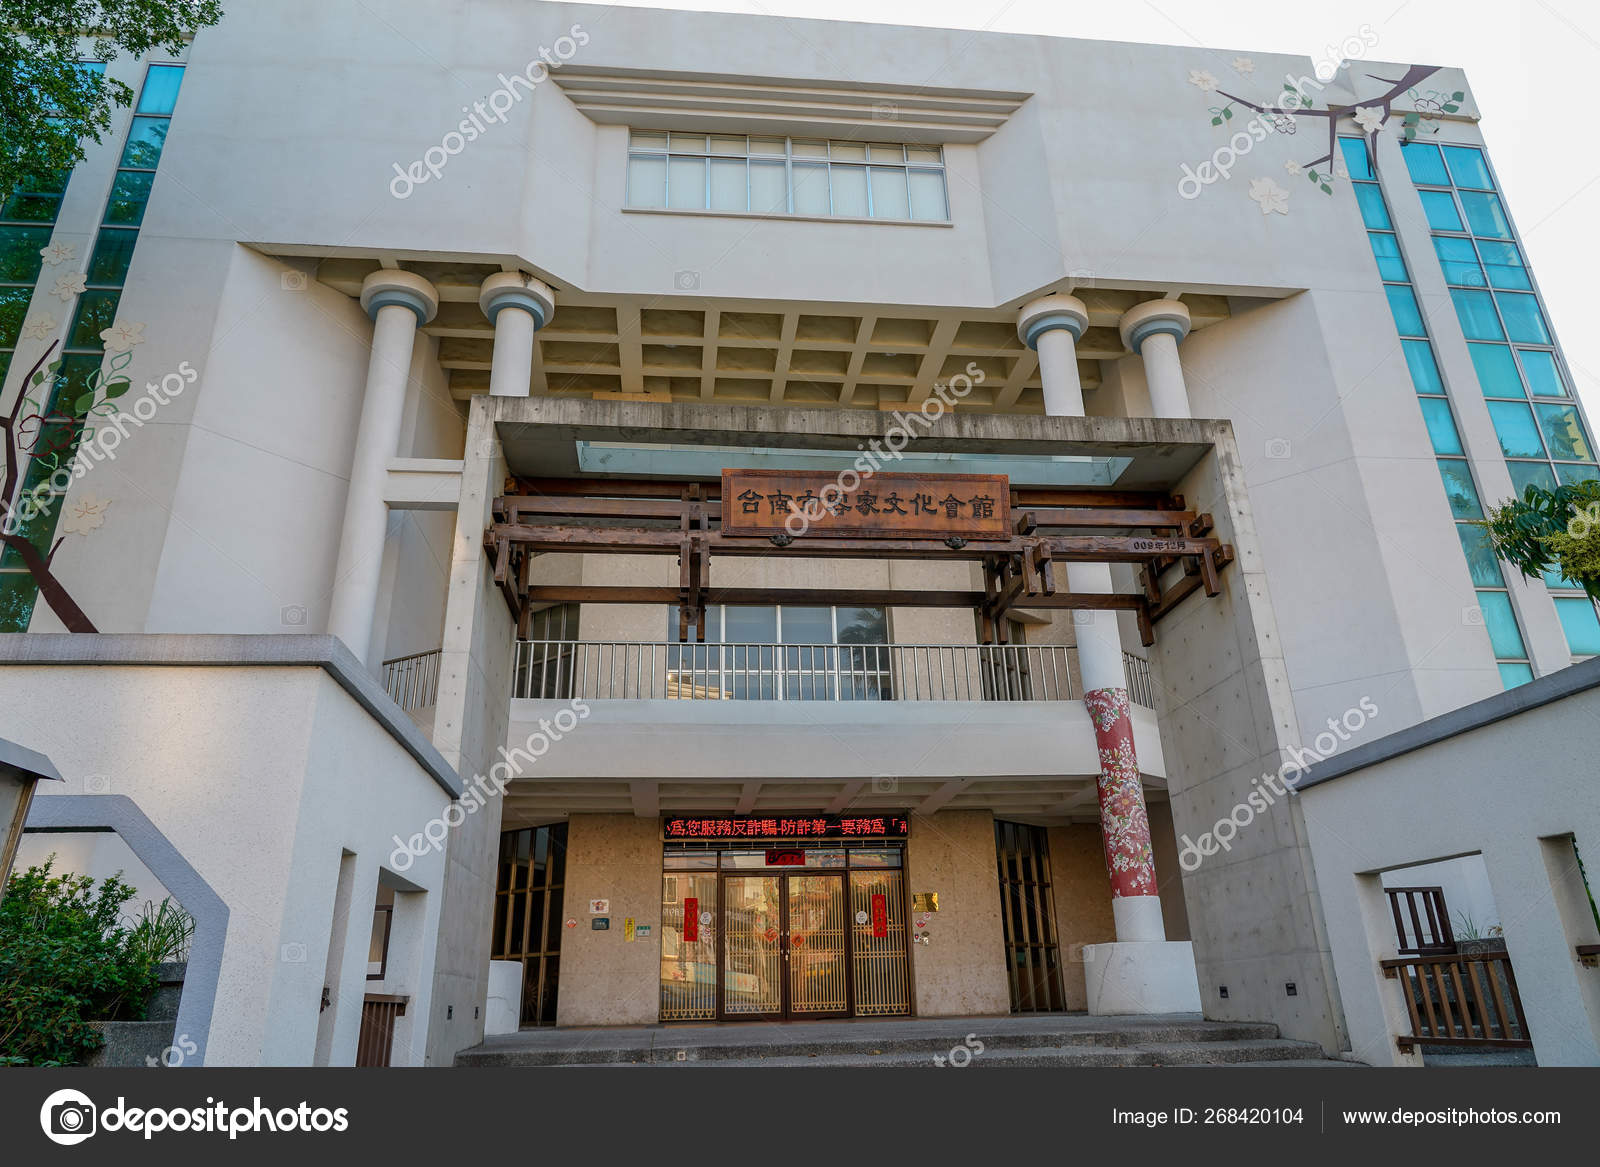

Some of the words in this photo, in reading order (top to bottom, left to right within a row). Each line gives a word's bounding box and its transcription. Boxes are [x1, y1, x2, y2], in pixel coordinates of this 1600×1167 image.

[737, 488, 996, 518] 台南市客家文化會館
